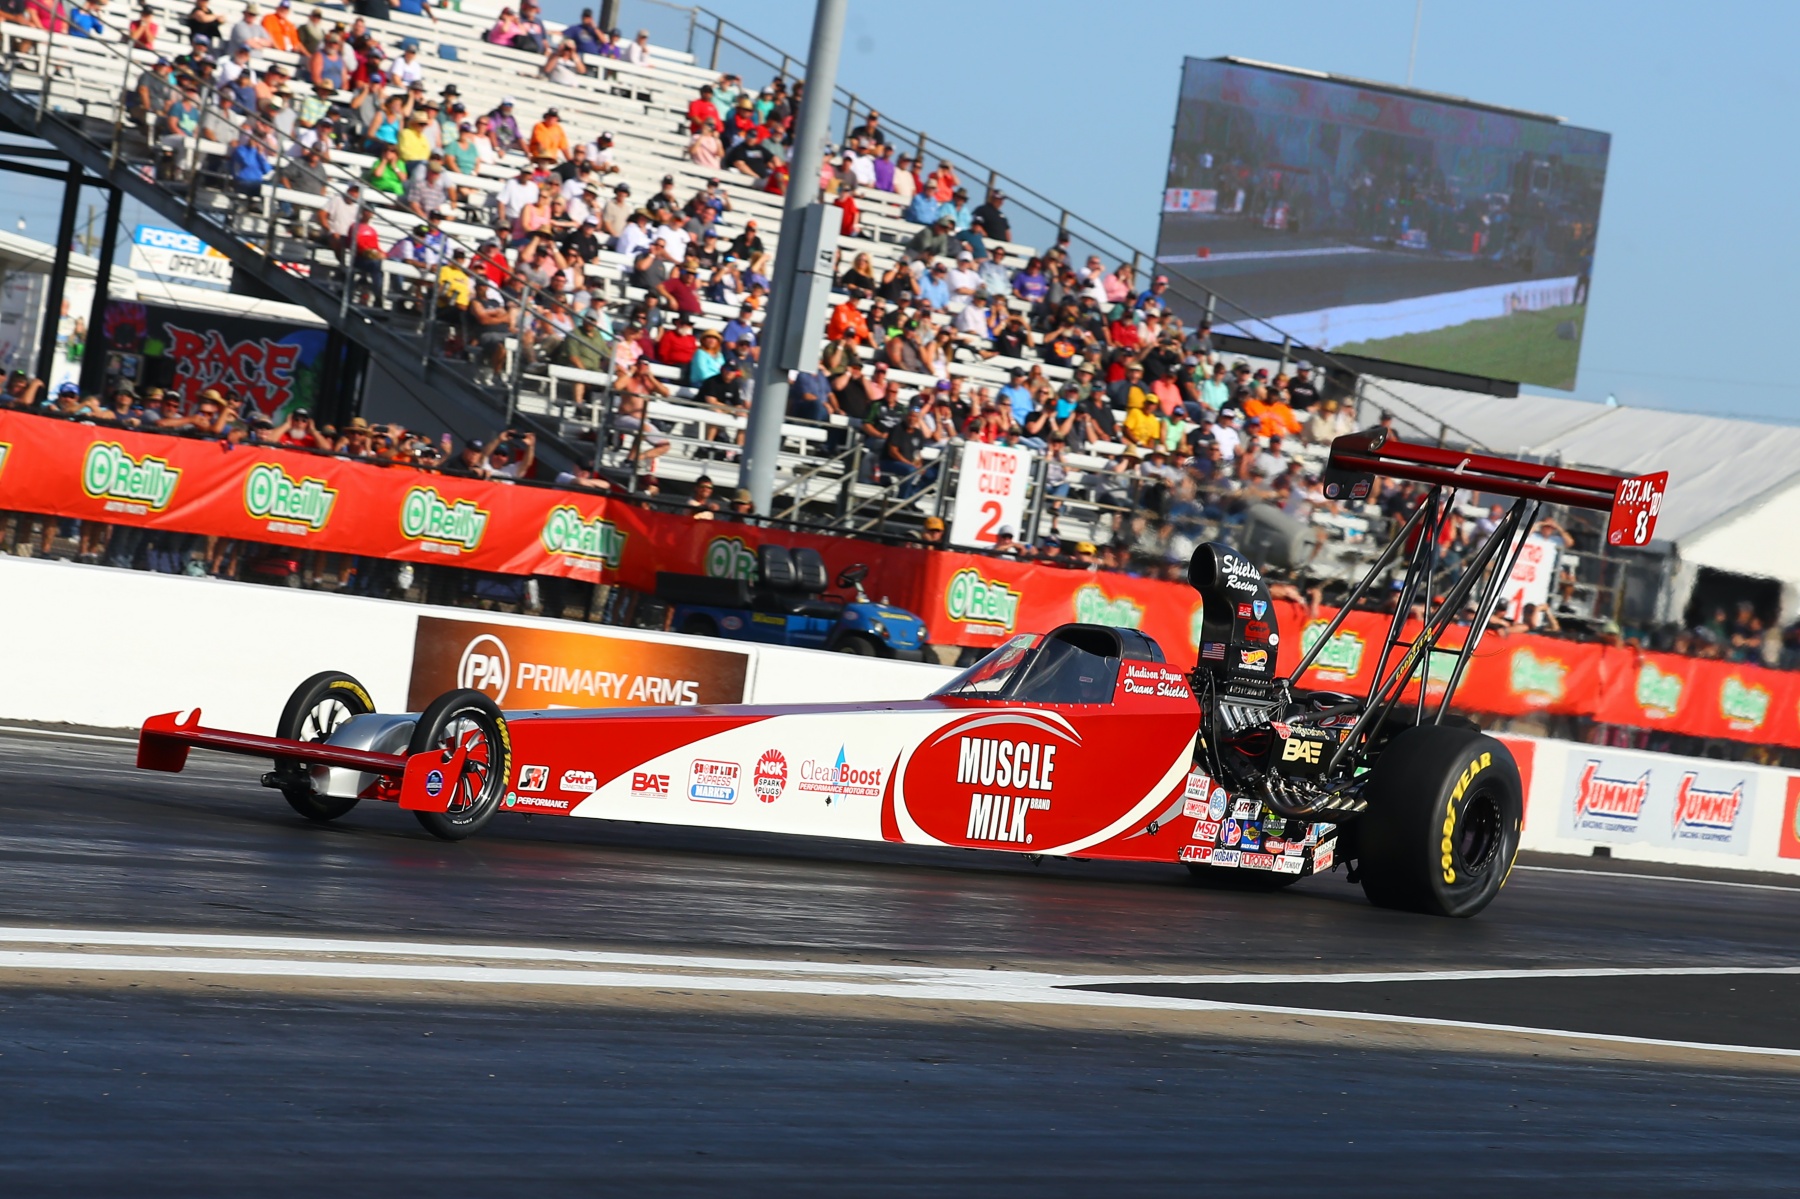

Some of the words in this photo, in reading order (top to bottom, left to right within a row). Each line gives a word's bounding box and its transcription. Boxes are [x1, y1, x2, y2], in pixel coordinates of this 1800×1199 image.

[140, 227, 201, 251] FORCE
[168, 254, 223, 279] OFFICIAL
[164, 322, 301, 390] RACE
[976, 450, 1017, 474] NITRO
[84, 444, 180, 509] O'Reilly
[978, 473, 1010, 496] CLUB
[245, 465, 337, 529] O'Reilly
[400, 488, 488, 550] O'Reilly
[975, 500, 1003, 543] 2
[1221, 554, 1262, 581] Shields
[1225, 575, 1259, 597] Racing
[464, 652, 502, 691] PA
[1125, 665, 1159, 680] Madison
[1159, 667, 1183, 685] Payne
[516, 661, 629, 700] PRIMARY
[629, 675, 700, 707] ARMS
[1123, 678, 1155, 695] Duane
[1156, 681, 1190, 699] Shields
[1281, 737, 1324, 765] BAE
[758, 760, 783, 777] NGK
[800, 759, 882, 786] CleanBoost
[956, 736, 1057, 791] MUSCLE
[631, 772, 671, 794] BAE
[694, 785, 732, 799] MARKET
[696, 774, 732, 787] EXPRESS
[757, 786, 780, 796] PLUGS
[758, 778, 781, 787] SPARK
[799, 783, 843, 794] PERFORMANCE
[843, 786, 865, 796] MOTOR
[865, 788, 879, 797] OILS
[1188, 776, 1208, 790] LUCAS
[1576, 763, 1647, 818] SUMMIT
[516, 796, 569, 809] PERFORMANCE
[1674, 773, 1742, 828] SUMMIT
[966, 793, 1031, 844] MILK
[1029, 798, 1051, 811] BRAND
[1195, 821, 1218, 837] MSD
[1441, 751, 1493, 885] GOODYEAR
[1182, 846, 1212, 859] ARP
[1213, 848, 1239, 863] HOGAN'S
